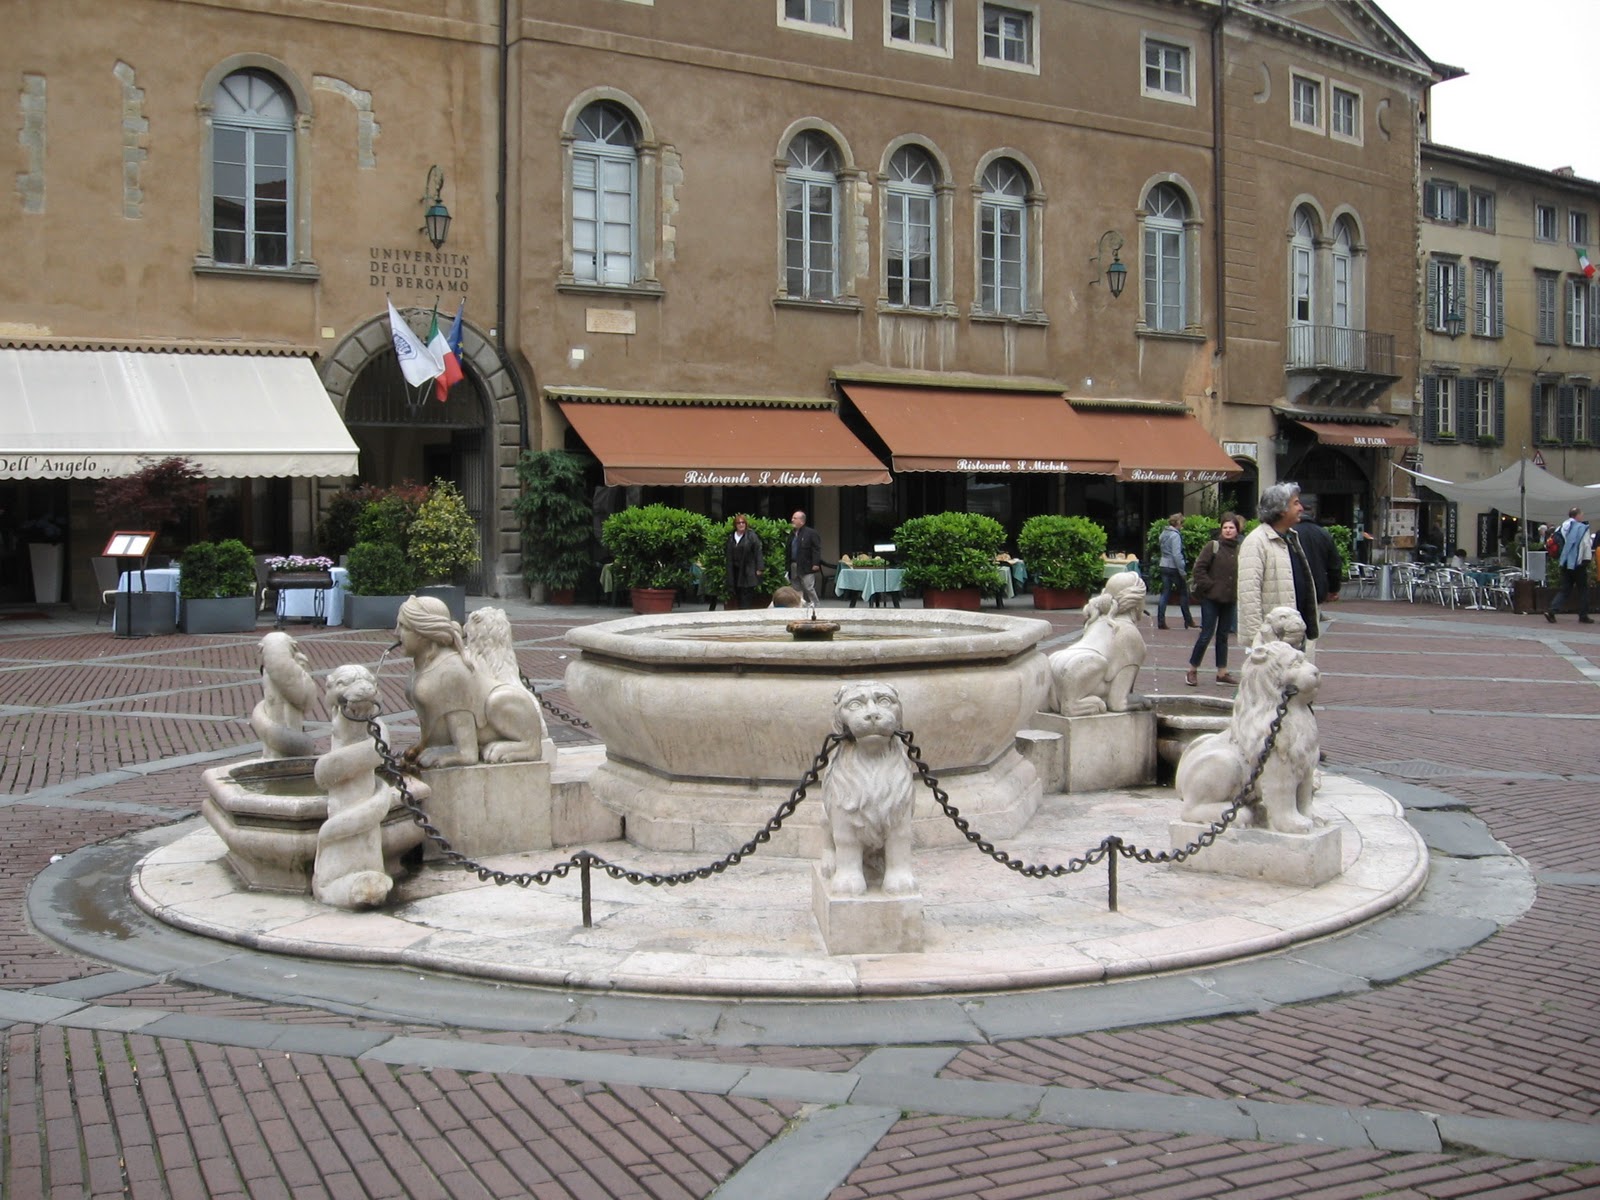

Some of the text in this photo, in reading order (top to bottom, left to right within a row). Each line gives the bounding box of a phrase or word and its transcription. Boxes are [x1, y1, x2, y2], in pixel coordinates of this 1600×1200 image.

[370, 261, 469, 279] DEGLI STUDI
[370, 275, 469, 292] DI BERGAMO
[1353, 436, 1367, 445] BAR
[956, 459, 1012, 471] Ristorante
[1029, 460, 1069, 472] Michele
[684, 470, 751, 485] Ristorante
[772, 472, 823, 485] Michele
[1131, 468, 1179, 481] Ristorante
[1193, 471, 1228, 482] Michele
